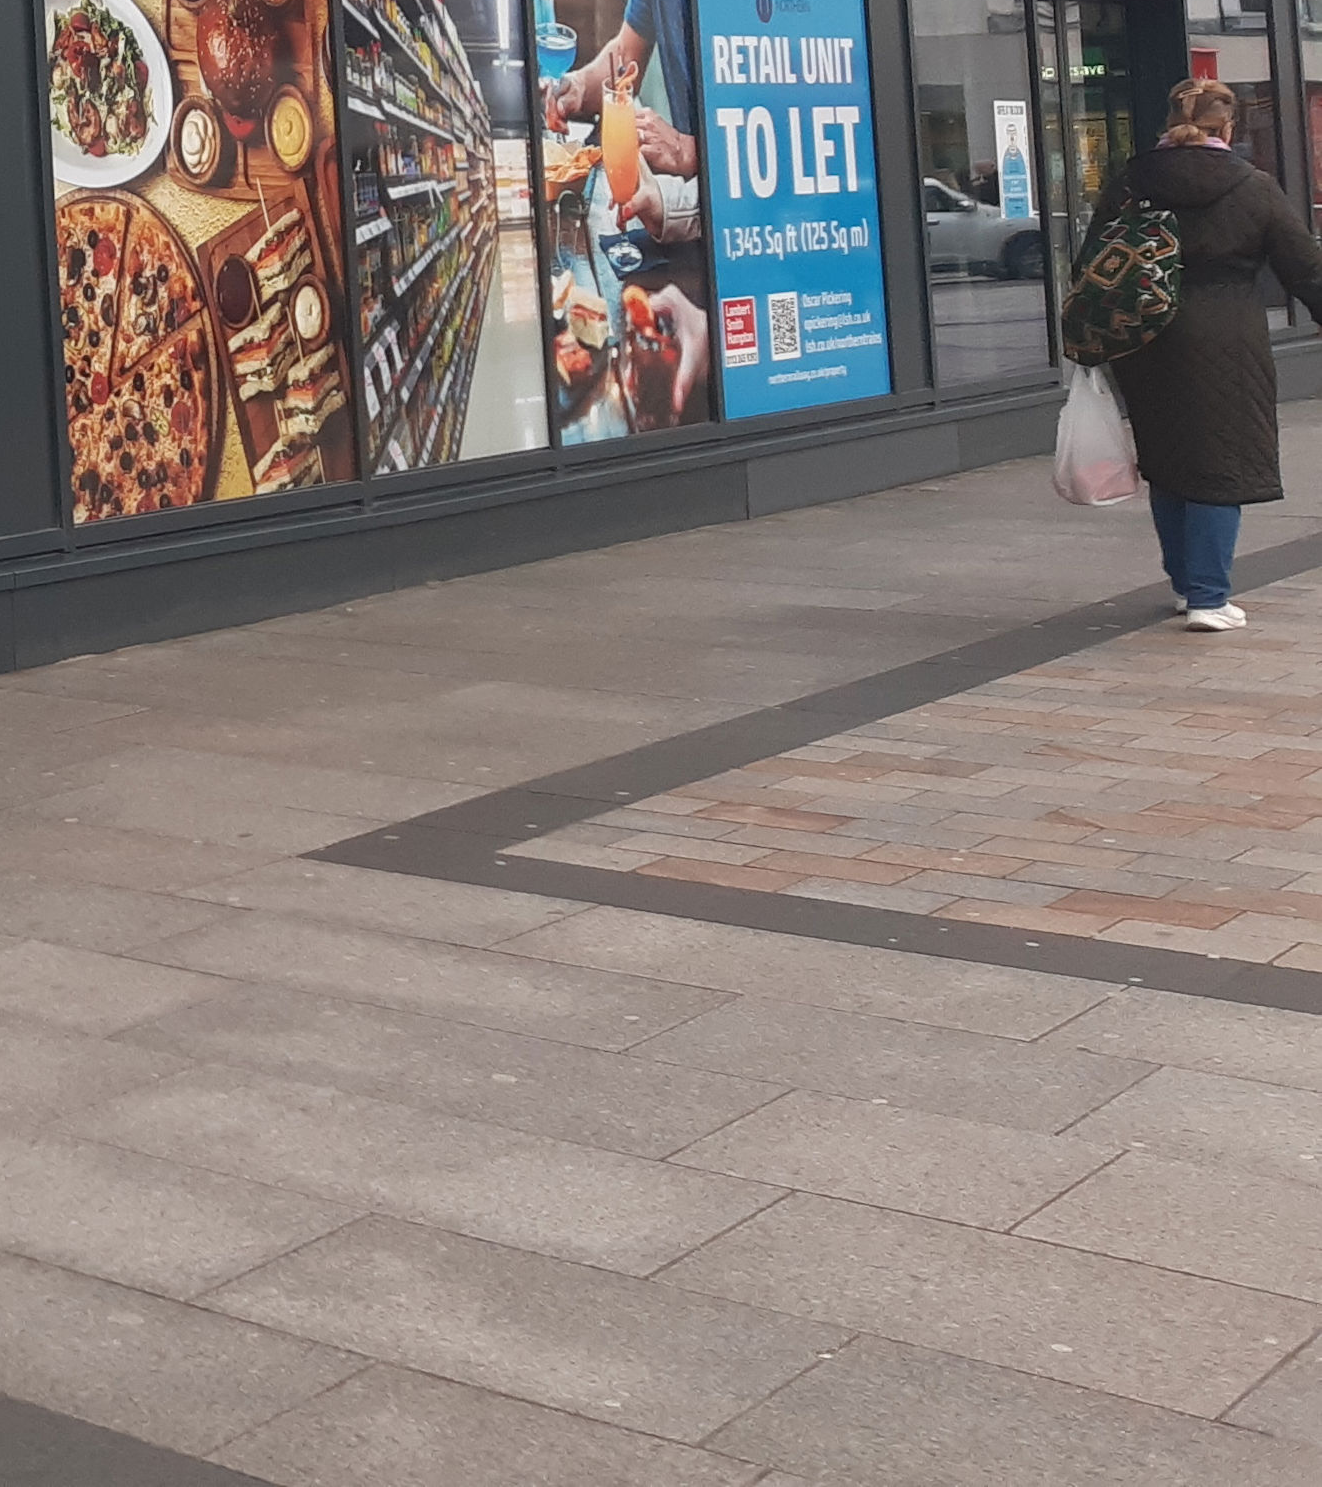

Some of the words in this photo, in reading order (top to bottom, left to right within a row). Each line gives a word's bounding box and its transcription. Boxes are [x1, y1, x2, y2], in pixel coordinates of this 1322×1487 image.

[712, 35, 797, 84] RETAIL
[800, 37, 853, 84] UNIT
[716, 106, 778, 199] TO
[788, 106, 859, 195] LET
[723, 226, 762, 260] 1,345
[765, 225, 784, 261] Sq
[785, 224, 798, 252] ft
[800, 221, 828, 251] (125
[831, 220, 848, 254] Sq
[850, 218, 869, 247] m)
